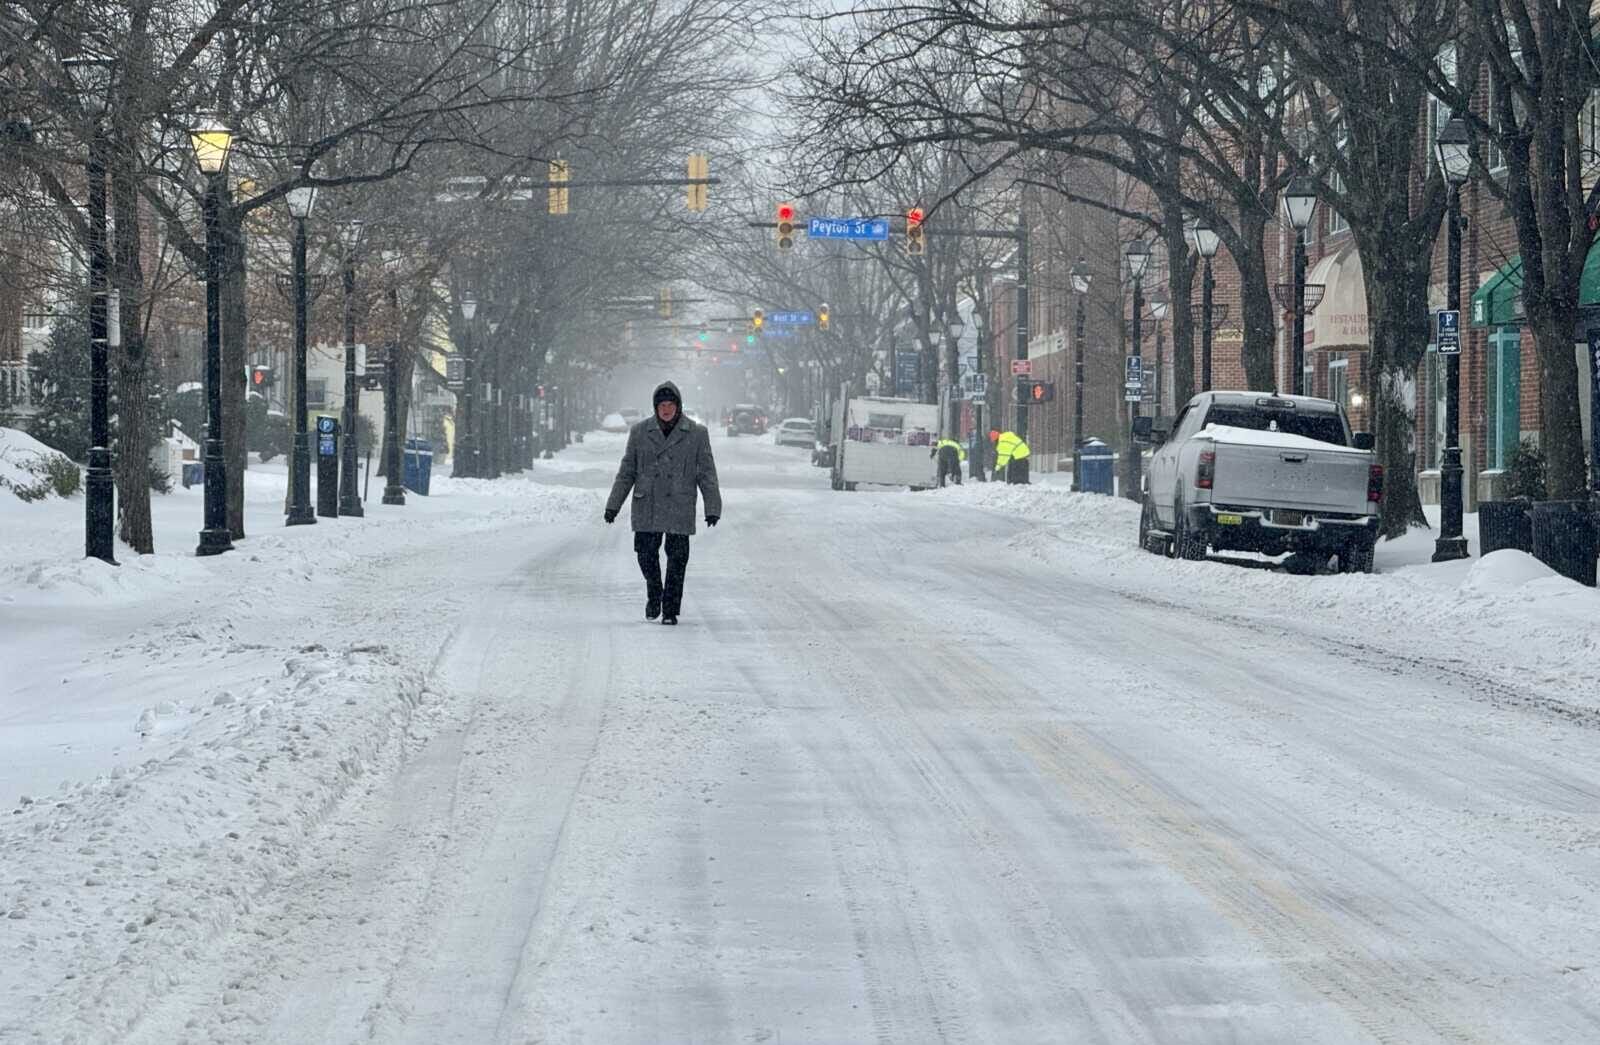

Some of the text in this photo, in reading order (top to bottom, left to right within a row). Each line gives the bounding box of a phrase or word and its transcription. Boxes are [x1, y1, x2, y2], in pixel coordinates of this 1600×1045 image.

[812, 219, 865, 236] Peyton St
[1445, 314, 1453, 326] P
[323, 420, 330, 430] P
